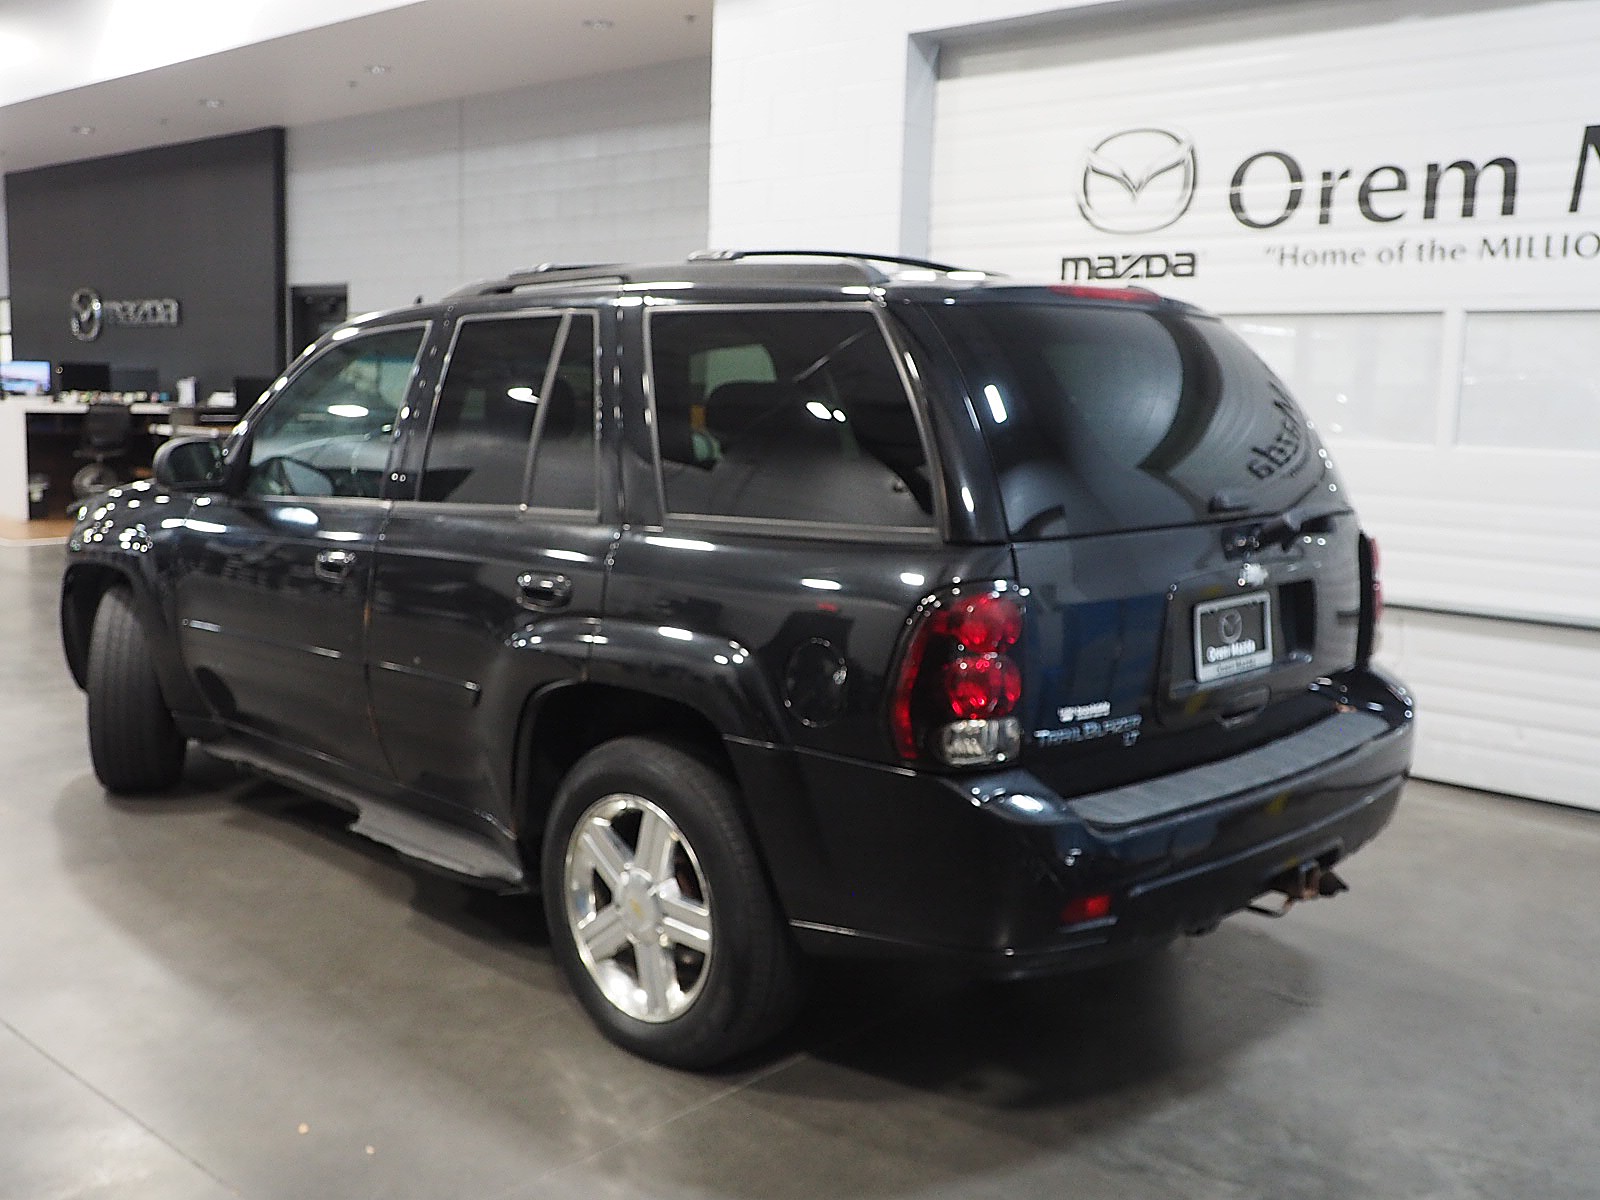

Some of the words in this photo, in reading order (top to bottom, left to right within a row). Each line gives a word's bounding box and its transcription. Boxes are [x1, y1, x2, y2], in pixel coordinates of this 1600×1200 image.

[1229, 151, 1518, 229] Orem
[1377, 239, 1407, 264] of
[1416, 238, 1467, 263] the
